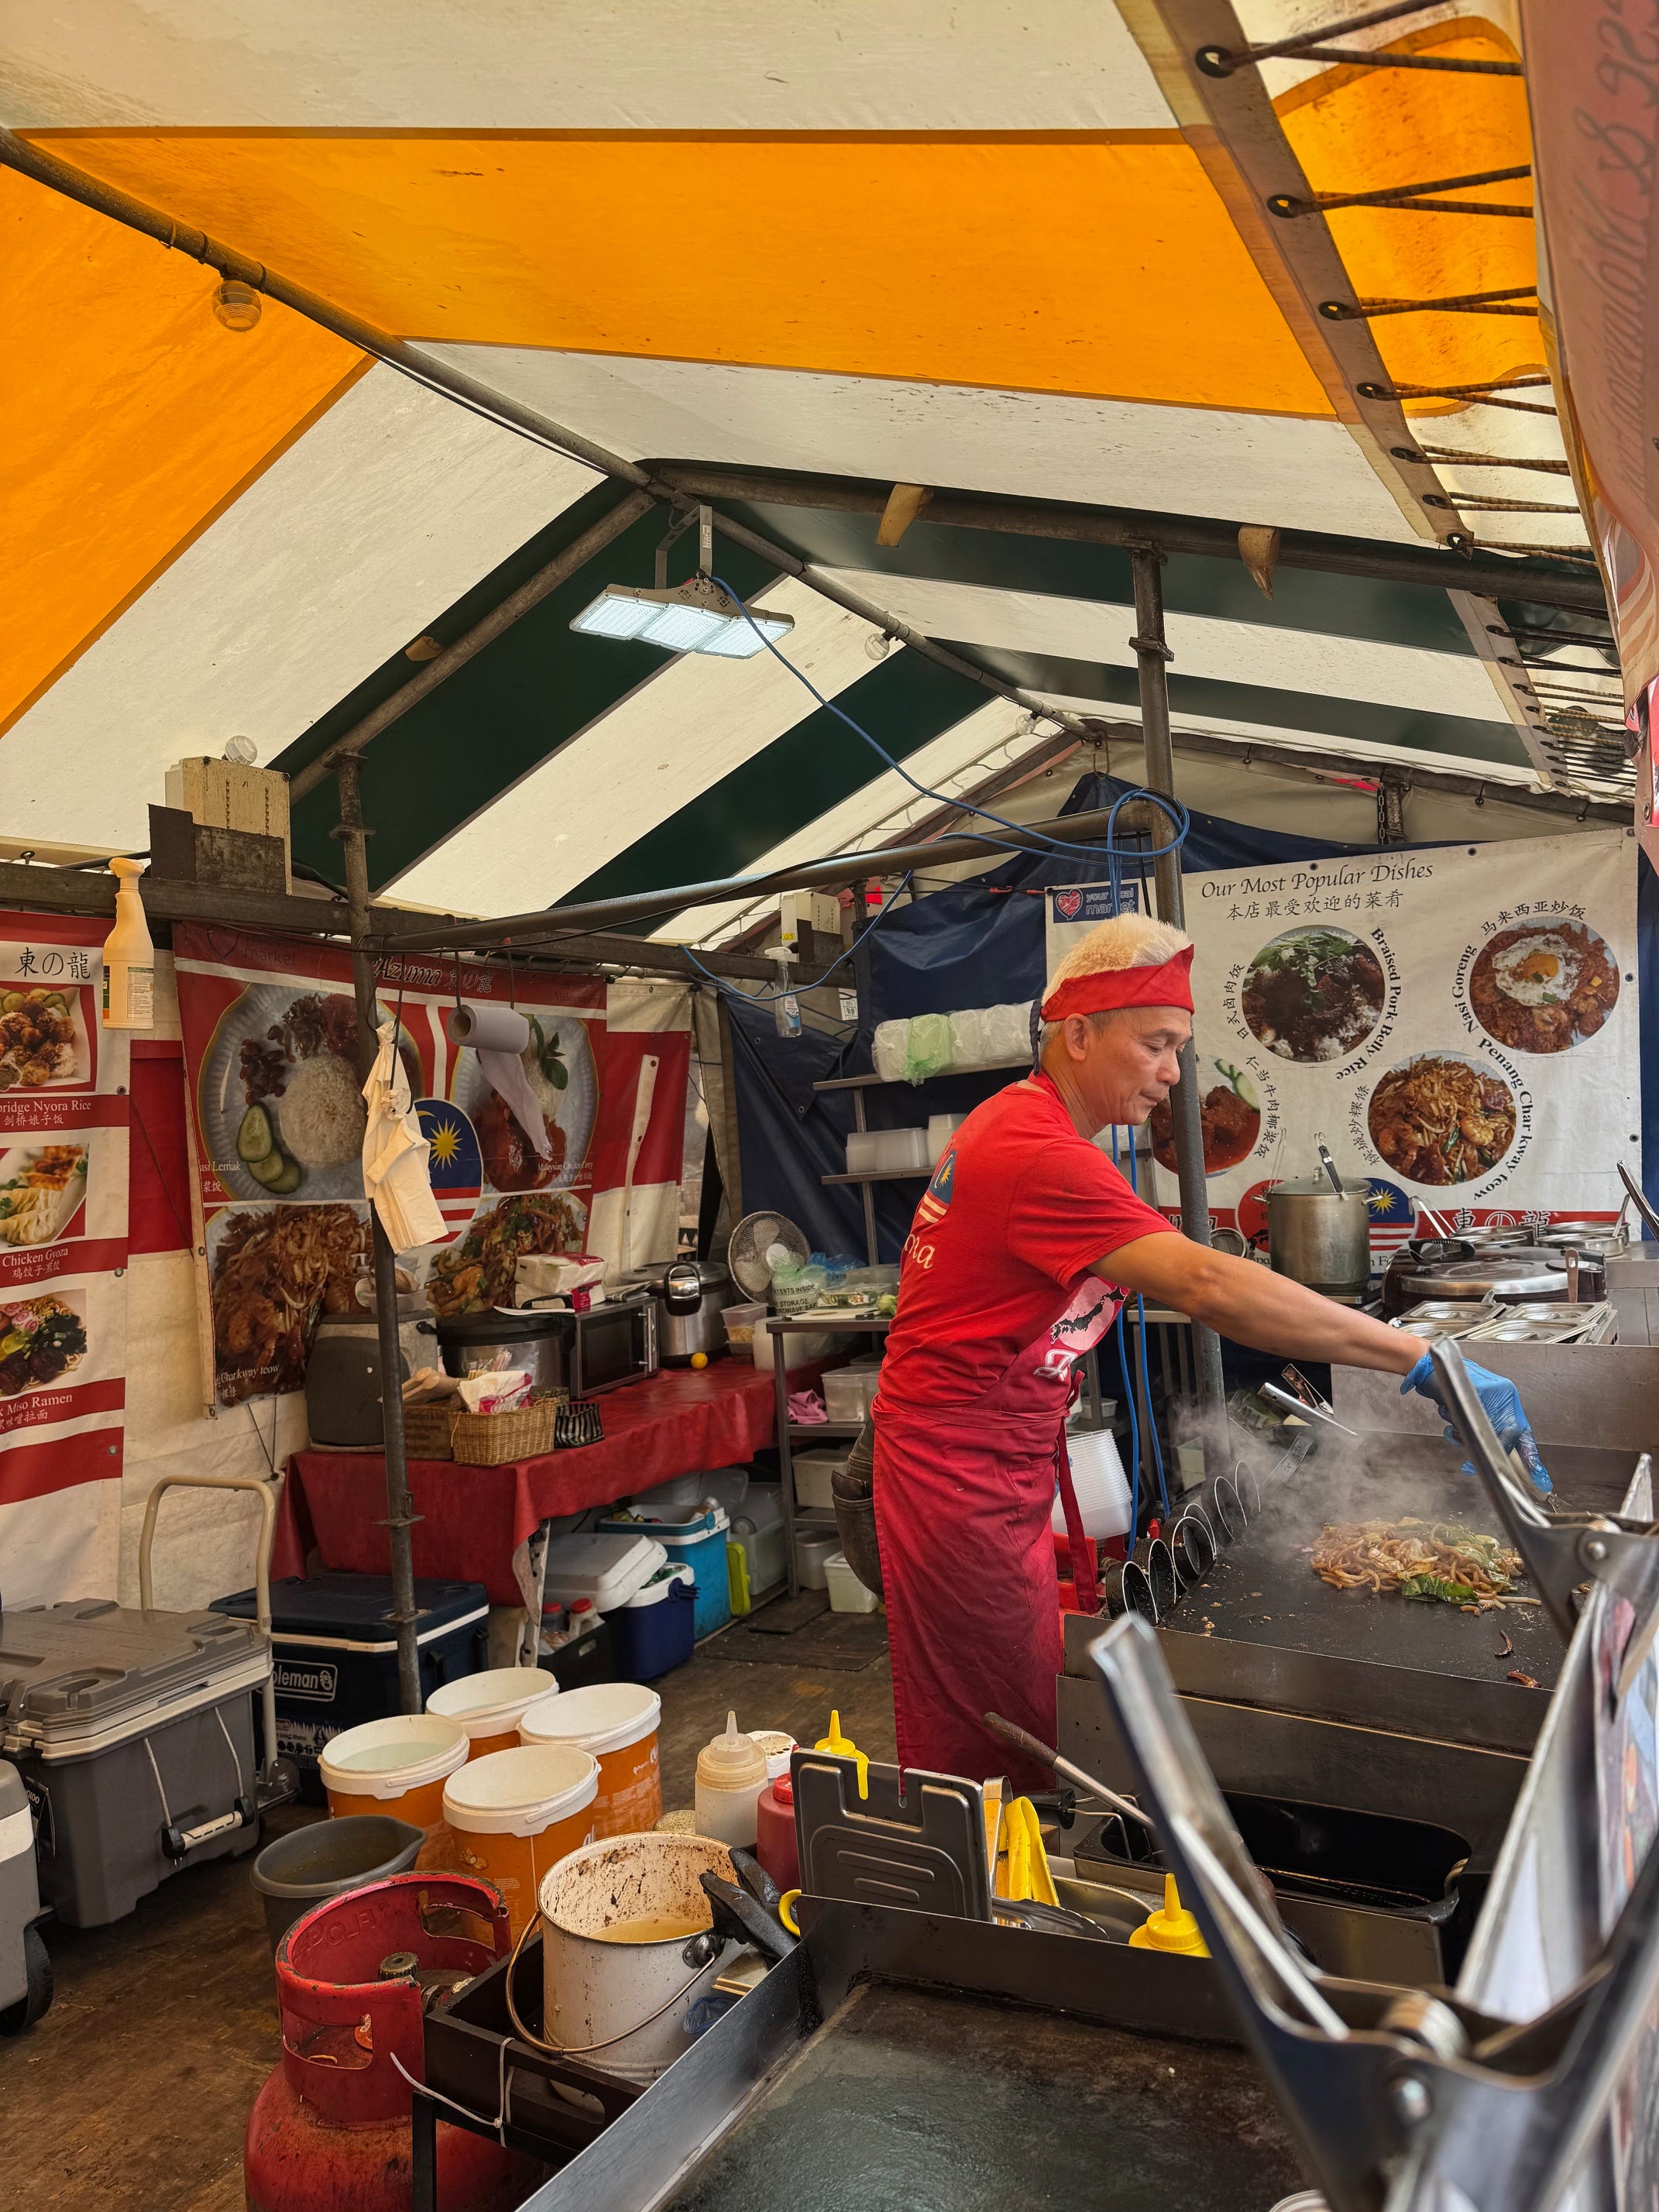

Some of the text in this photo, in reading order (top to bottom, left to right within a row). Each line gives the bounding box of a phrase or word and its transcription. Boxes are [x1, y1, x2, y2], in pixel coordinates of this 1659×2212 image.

[1201, 857, 1434, 898] Our Most Popular Dishes
[1086, 891, 1109, 902] your
[1086, 898, 1135, 915] maret
[1226, 888, 1403, 922] 本店最受欢迎的菜肴
[1481, 900, 1586, 936] 马来西亚炒饭
[15, 946, 91, 979] 東の龍
[243, 946, 298, 966] market
[1452, 943, 1480, 1035] Nasi Goreng
[1335, 926, 1402, 1080] Braised Pork Belly Rice
[33, 1101, 68, 1115] Nyora
[71, 1099, 91, 1111] Rice
[1474, 1038, 1534, 1200] Penang Char kway teow
[212, 1161, 241, 1171] Lemak
[2, 1248, 69, 1267] Chicken Gyoza
[795, 1283, 816, 1293] INSIDE
[780, 1298, 809, 1307] STORAGE
[805, 1302, 818, 1310] SAF
[7, 1400, 29, 1416] Miso
[32, 1394, 73, 1408] Ramen
[273, 1664, 319, 1690] oleman
